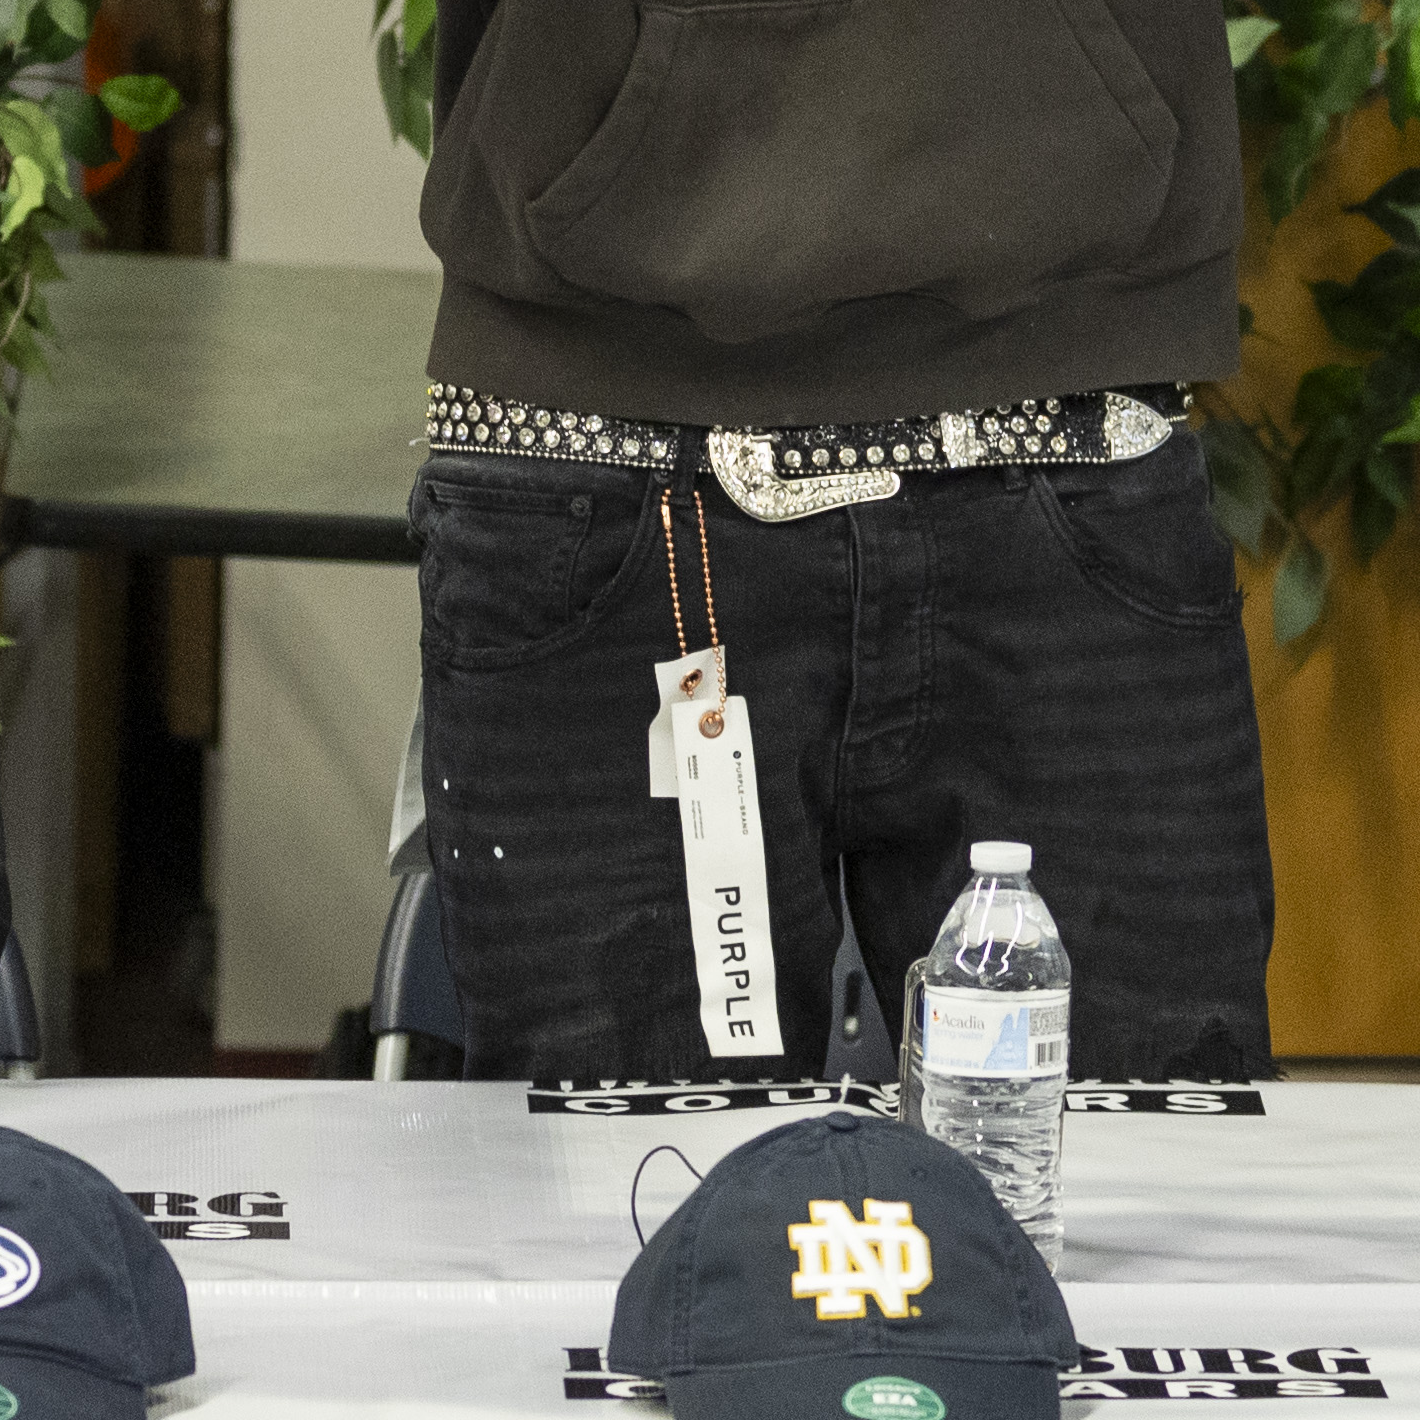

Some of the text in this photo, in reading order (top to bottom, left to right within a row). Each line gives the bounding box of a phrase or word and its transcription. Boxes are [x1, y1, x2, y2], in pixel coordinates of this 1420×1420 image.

[714, 886, 755, 1038] PURPLE
[941, 1012, 985, 1030] Acadia
[788, 1197, 933, 1321] ND
